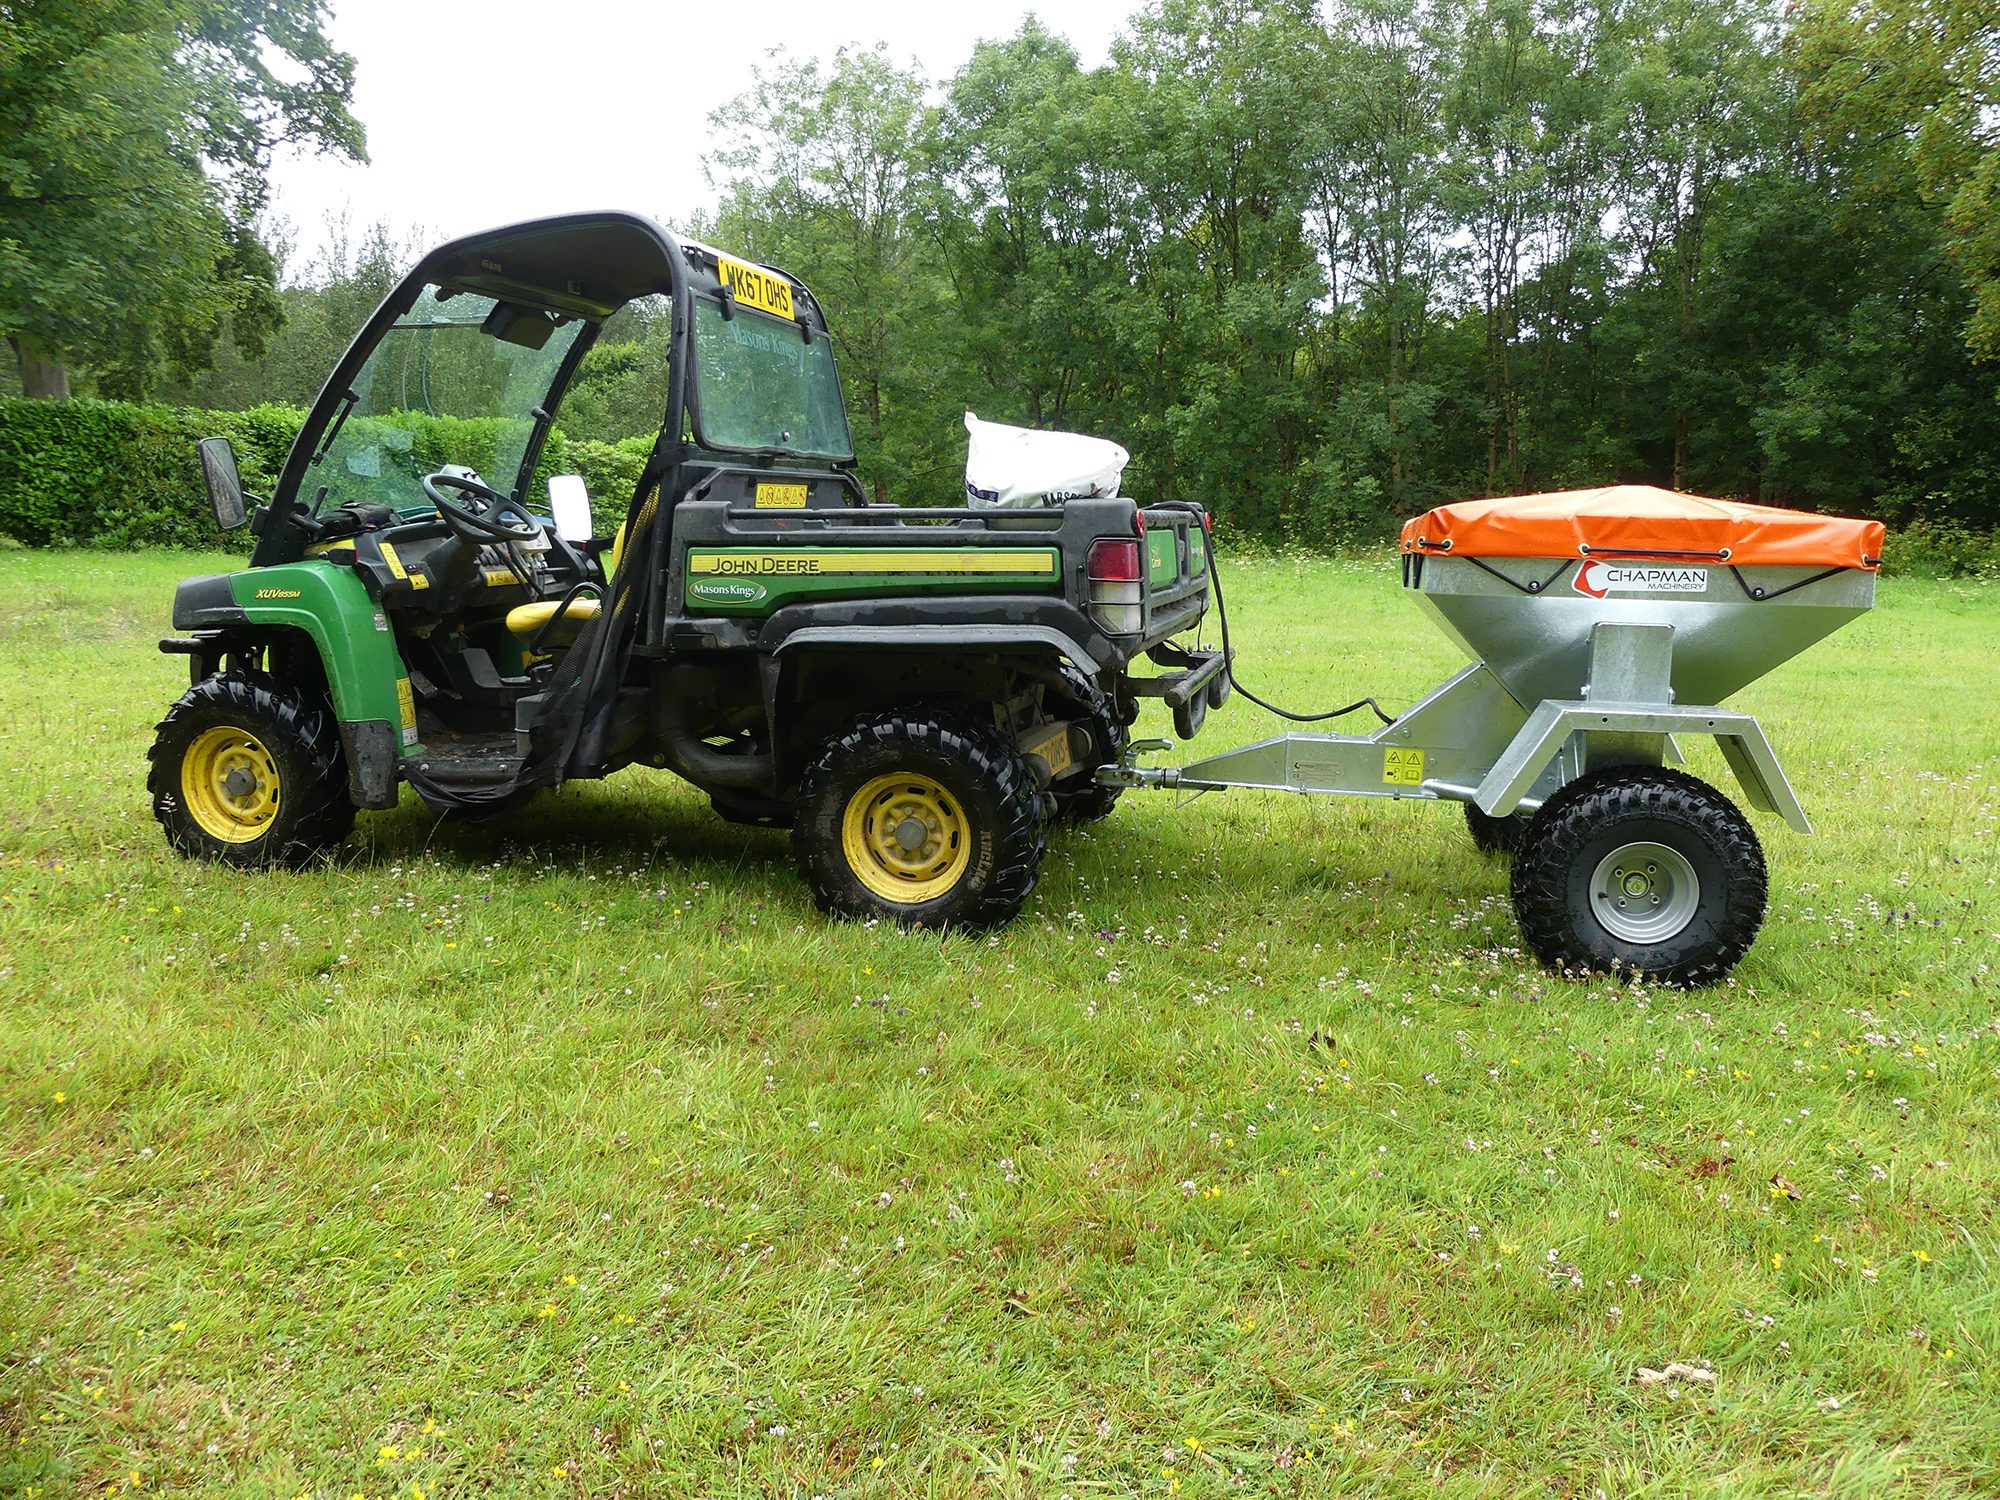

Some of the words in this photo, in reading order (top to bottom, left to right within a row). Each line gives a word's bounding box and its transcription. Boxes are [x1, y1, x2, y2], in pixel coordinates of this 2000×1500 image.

[726, 264, 762, 303] WK67
[765, 278, 789, 313] OHS
[711, 557, 757, 572] JOHN
[762, 557, 819, 572] DEERE
[1607, 570, 1705, 582] CHAPMAN
